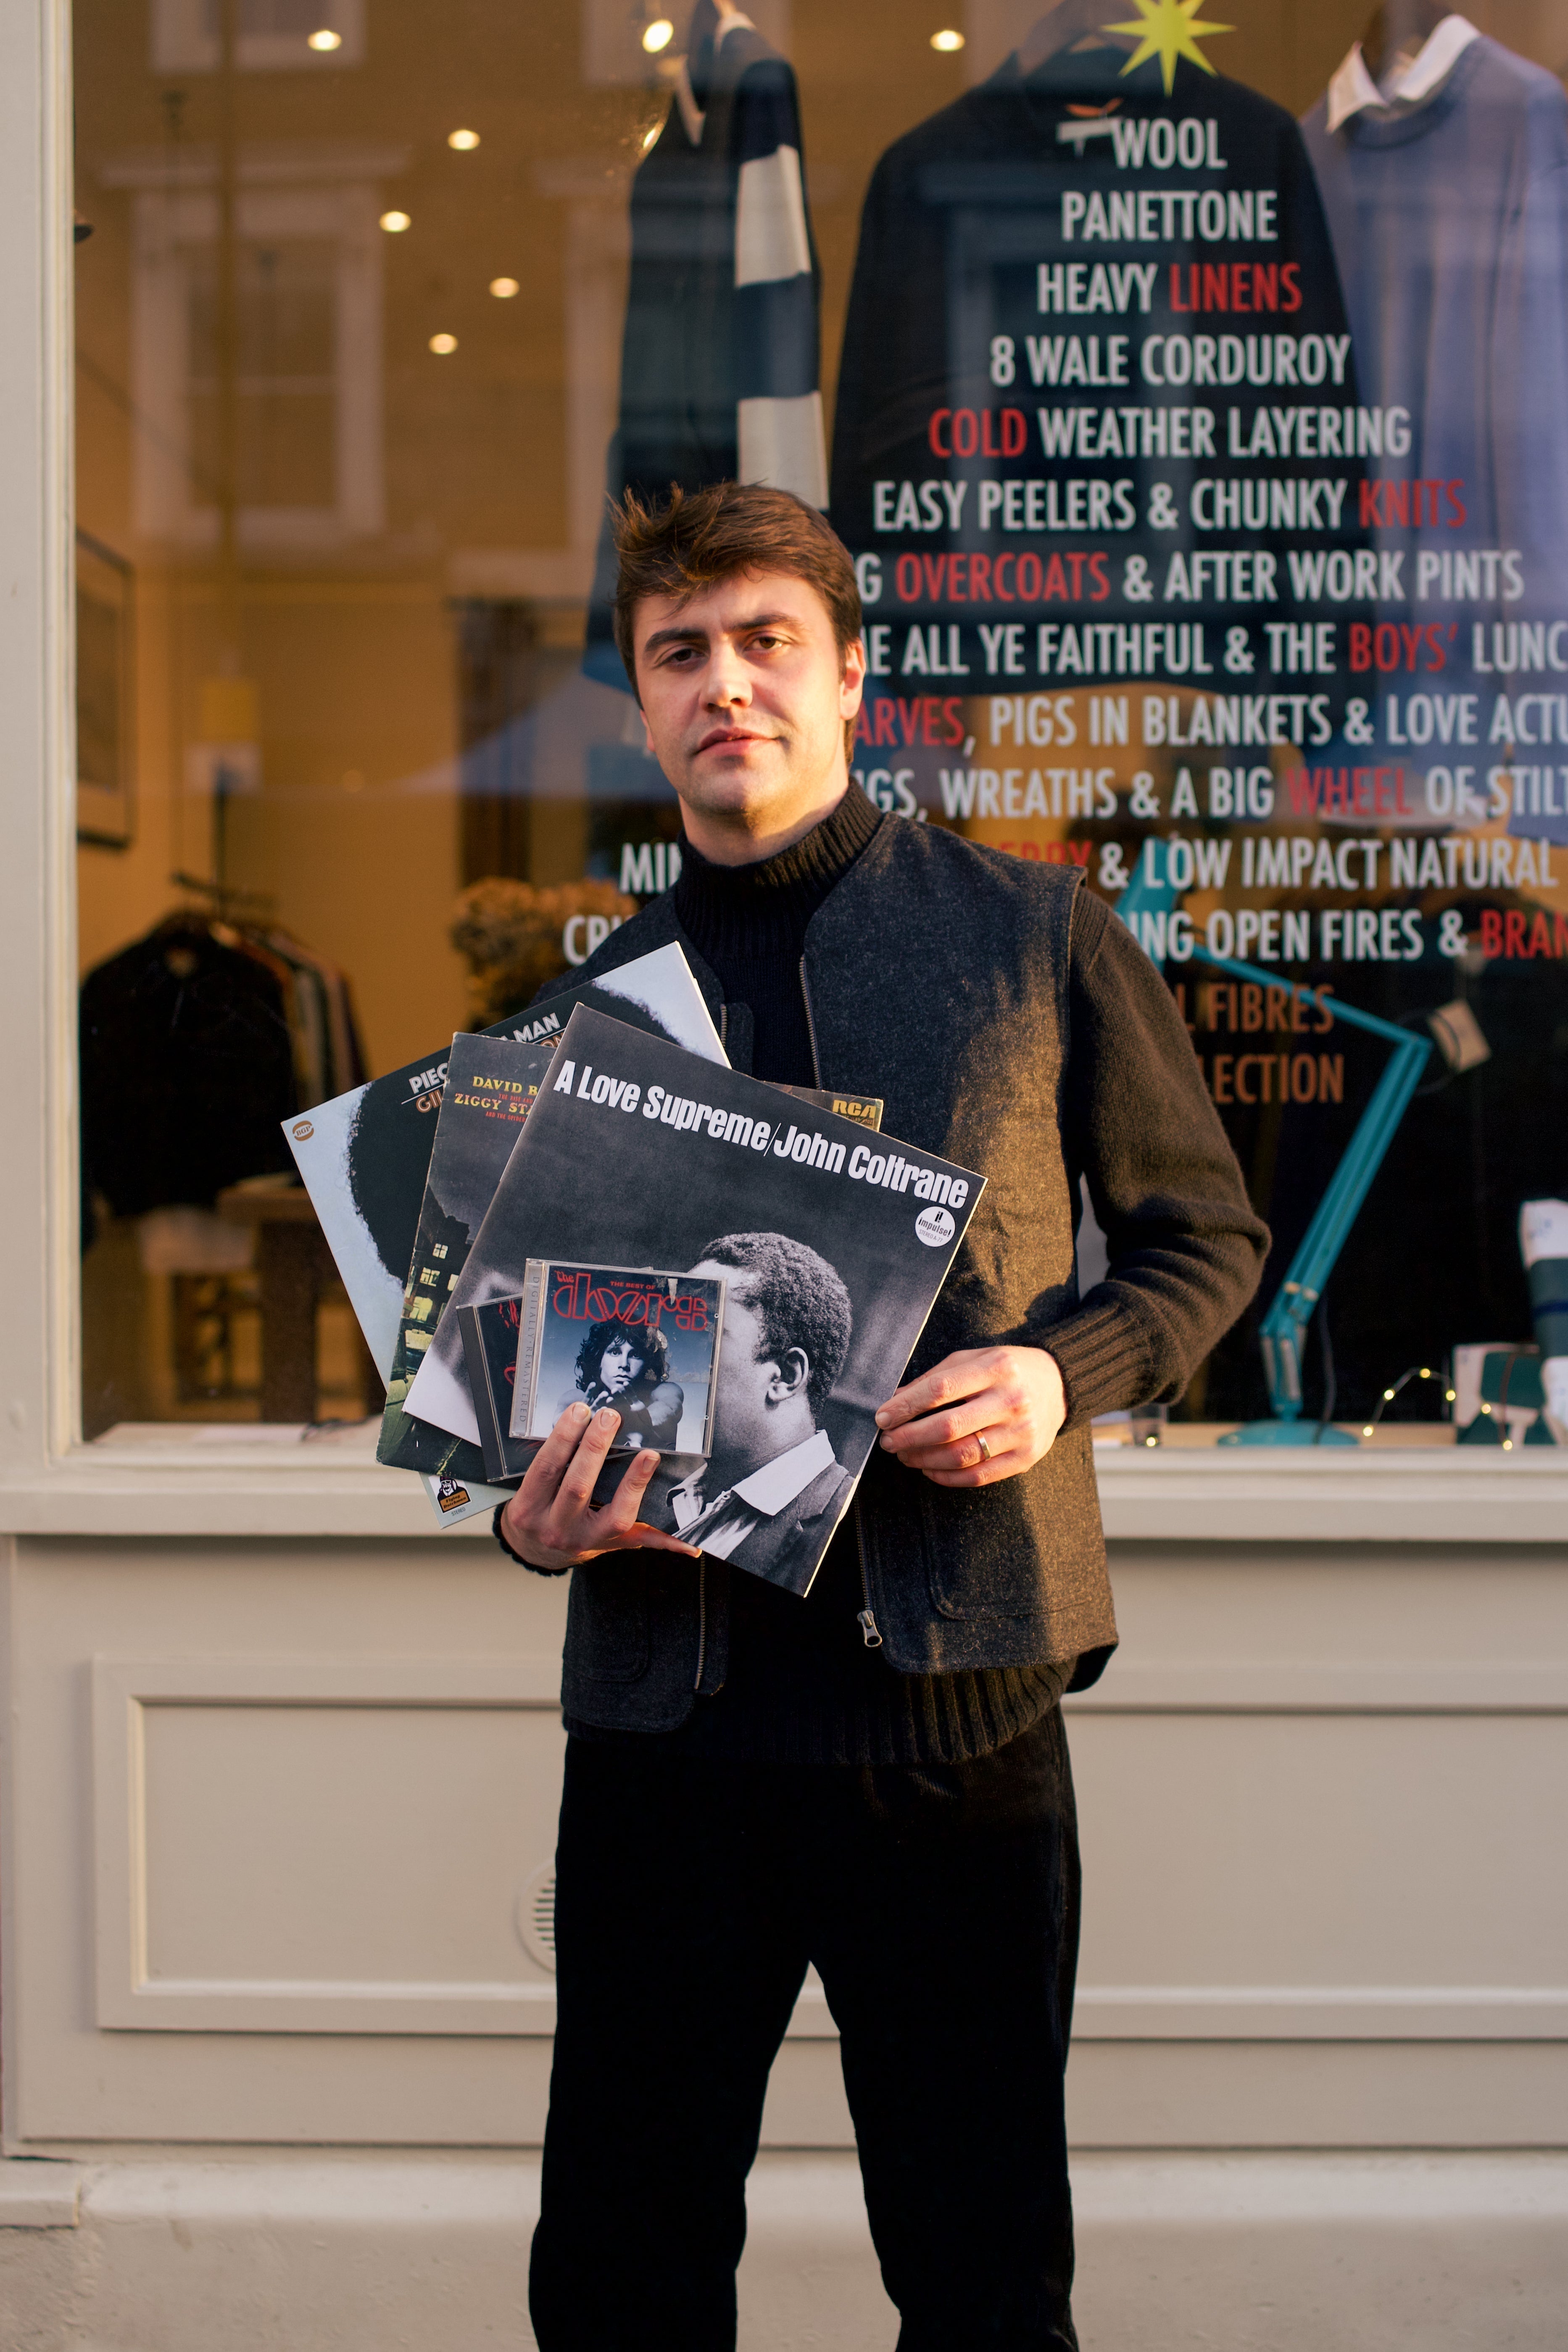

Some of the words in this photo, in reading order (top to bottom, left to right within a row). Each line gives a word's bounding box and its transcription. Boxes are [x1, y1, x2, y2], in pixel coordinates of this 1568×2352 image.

[1110, 118, 1227, 169] WOOL
[1062, 190, 1278, 242] PANETTONE
[1038, 263, 1158, 314] HEAVY
[1170, 263, 1302, 314] LINENS
[990, 335, 1015, 386] 8
[1026, 335, 1130, 386] WALE
[1141, 335, 1351, 386] CORDUROY
[929, 408, 1028, 458] COLD
[1039, 408, 1216, 458] WEATHER
[1229, 408, 1411, 458] LAYERING
[874, 480, 967, 531] EASY
[980, 480, 1134, 531] PEELERS
[1148, 481, 1178, 531] &
[1191, 480, 1348, 531] CHUNKY
[1359, 480, 1467, 530] KNITS
[850, 551, 883, 605] G
[895, 552, 1110, 602] OVERCOATS
[1124, 553, 1153, 602] &
[1165, 552, 1278, 602] AFTER
[1287, 552, 1403, 602] WORK
[1417, 552, 1524, 602] PINTS
[902, 625, 969, 675] ALL
[979, 625, 1024, 675] YE
[1039, 625, 1212, 675] FAITHFUL
[1224, 626, 1254, 675] &
[1265, 625, 1336, 675] THE
[990, 696, 1077, 746] PIGS
[1090, 696, 1127, 746] IN
[1143, 696, 1331, 746] BLANKETS
[1344, 697, 1374, 746] &
[1385, 696, 1479, 746] LOVE
[939, 768, 1117, 819] WREATHS
[1131, 770, 1160, 818] &
[1170, 768, 1196, 819] A
[1210, 768, 1273, 818] BIG
[1287, 767, 1412, 817] WHEEL
[1425, 767, 1476, 817] OF
[1099, 841, 1128, 890] &
[1144, 840, 1231, 890] LOW
[1242, 840, 1378, 891] IMPACT
[1390, 839, 1558, 890] NATURAL
[1207, 911, 1311, 962] OPEN
[1321, 911, 1424, 962] FIRES
[1438, 911, 1467, 960] &
[513, 1012, 560, 1042] MAN
[1209, 984, 1334, 1034] FIBRES
[455, 1093, 502, 1110] ZIGGY
[473, 1076, 522, 1094] DAVID
[833, 1100, 876, 1118] RCA
[296, 1126, 311, 1136] BGP
[553, 1059, 576, 1095] A
[576, 1065, 641, 1113] Love
[848, 1145, 969, 1209] Coltrane
[918, 1217, 951, 1237] impulse!
[919, 1229, 933, 1239] STEREO
[519, 1346, 533, 1422] REMASTERED
[444, 1497, 466, 1509] Dutchman
[446, 1495, 461, 1503] Flying
[451, 1507, 466, 1516] STEREO
